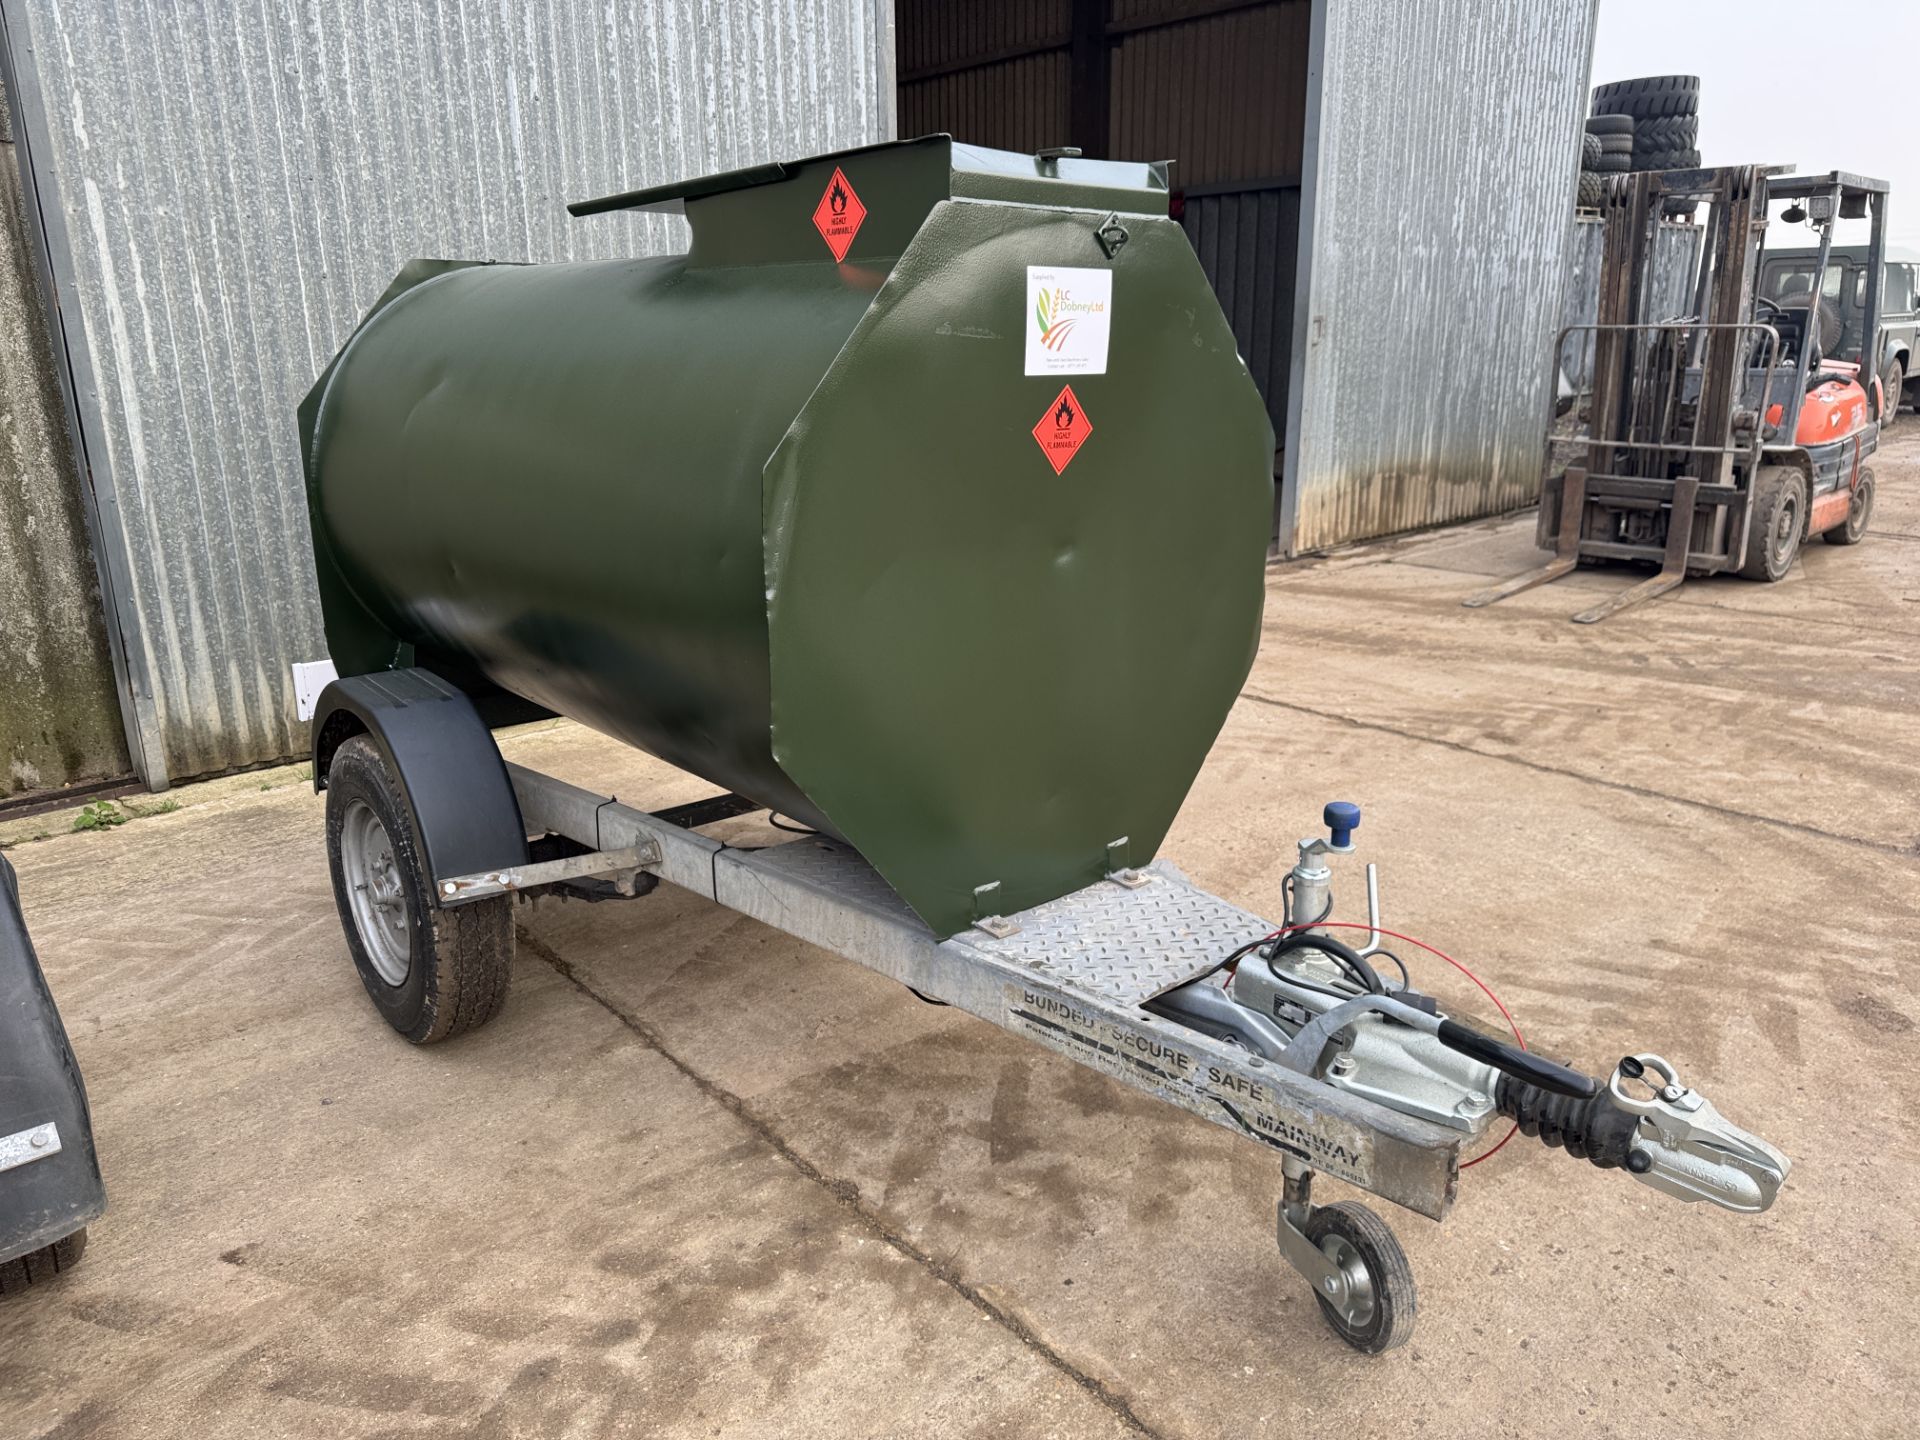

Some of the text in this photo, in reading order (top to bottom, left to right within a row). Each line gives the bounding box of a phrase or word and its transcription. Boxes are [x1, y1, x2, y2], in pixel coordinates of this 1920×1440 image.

[831, 217, 847, 226] HIGHLY
[826, 226, 854, 236] FLAMMABLE
[1060, 290, 1071, 300] LC
[1053, 431, 1071, 441] HIGHLY
[1046, 441, 1077, 450] FLAMMABLE
[1111, 1025, 1188, 1070] SECURE
[1208, 1067, 1263, 1102] SAFE
[1257, 1112, 1362, 1168] MAINWAY
